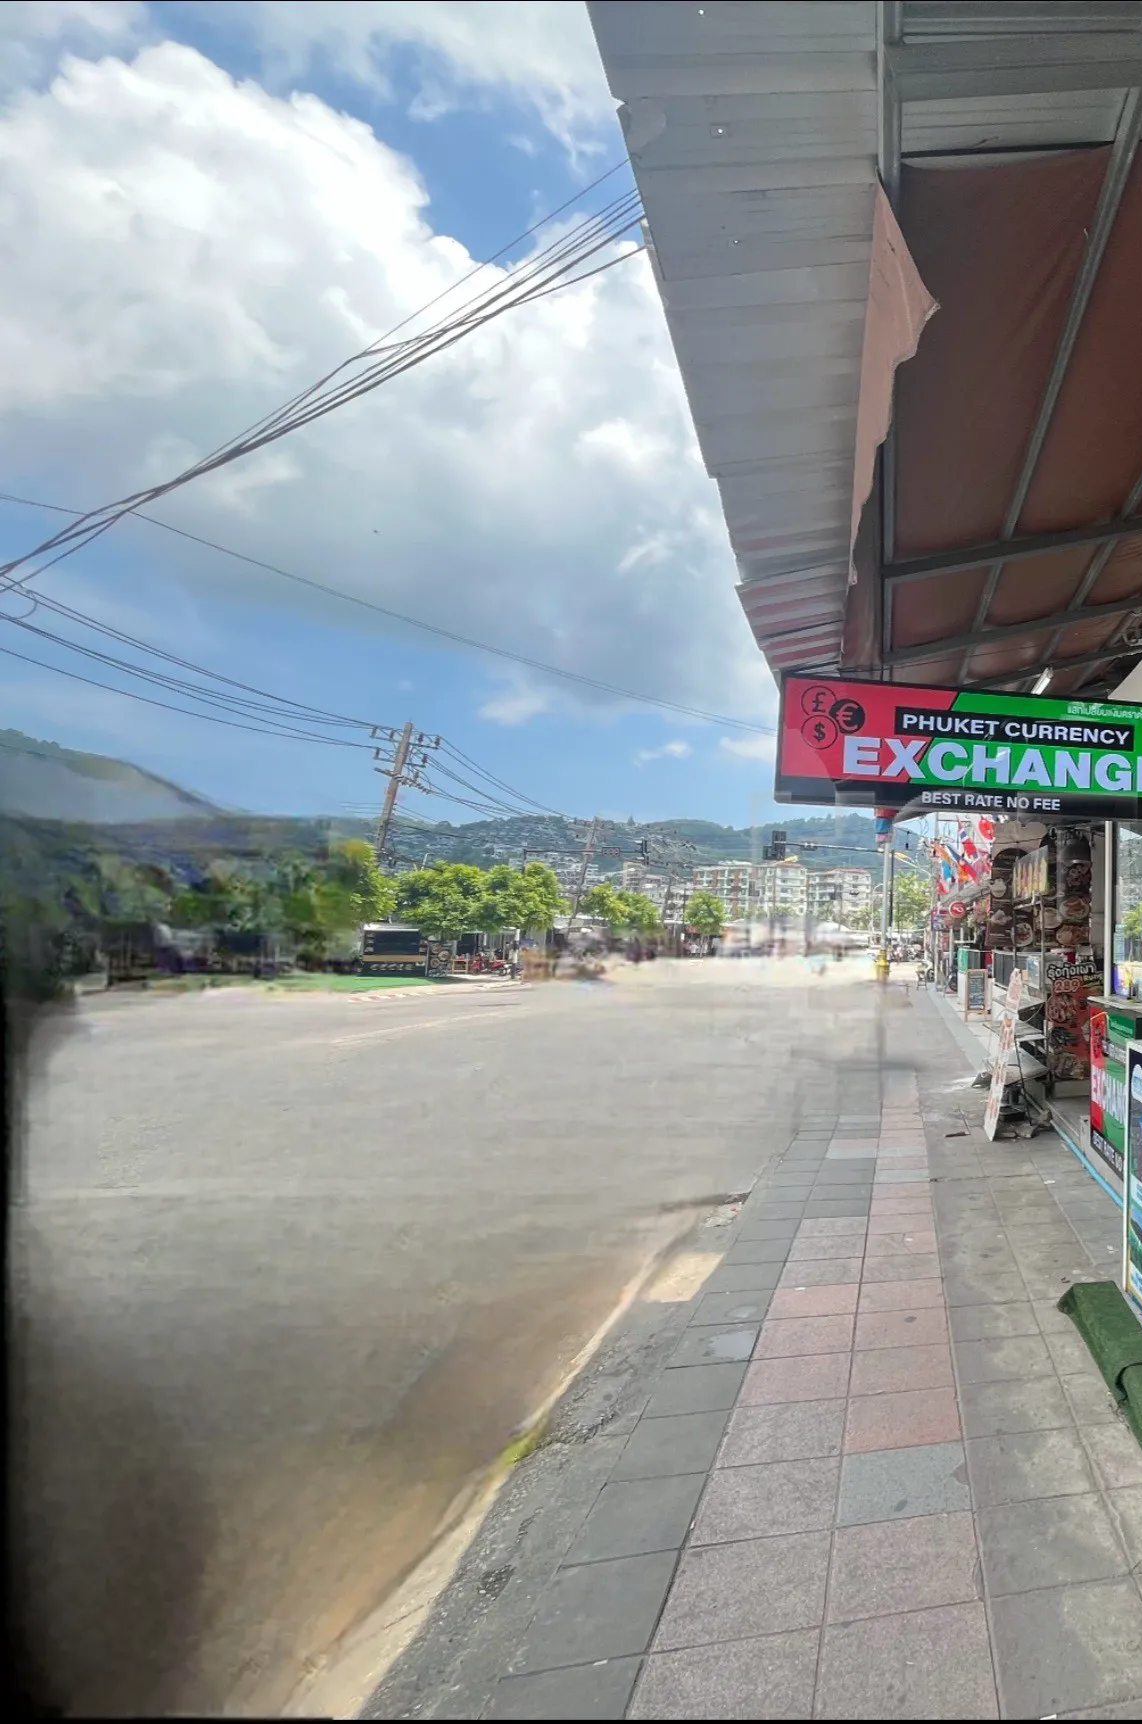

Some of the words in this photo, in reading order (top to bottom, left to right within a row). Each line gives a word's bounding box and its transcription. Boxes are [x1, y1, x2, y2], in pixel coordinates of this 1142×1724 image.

[902, 713, 1000, 736] PHUKET
[1005, 722, 1131, 745] CURRENCY
[922, 791, 961, 805] BEST
[965, 794, 1003, 807] RATE
[1007, 796, 1029, 809] NO
[1034, 798, 1060, 810] FEE
[1054, 979, 1081, 994] 289
